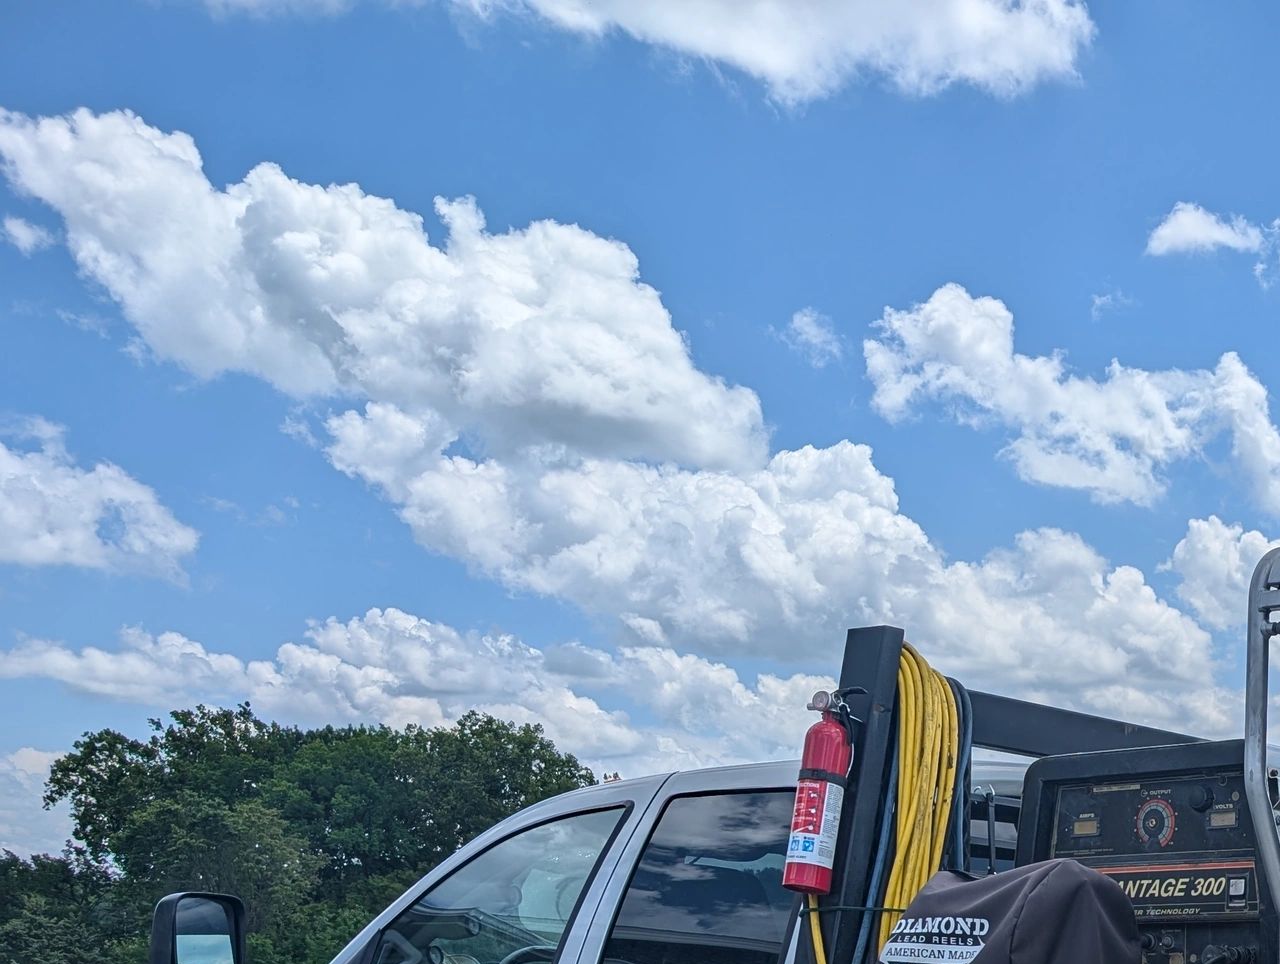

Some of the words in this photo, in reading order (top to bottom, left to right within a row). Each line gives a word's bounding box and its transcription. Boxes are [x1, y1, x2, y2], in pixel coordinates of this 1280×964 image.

[1191, 877, 1226, 896] 300
[1146, 908, 1201, 916] TECHNOLOGY
[892, 917, 989, 936] DIAMOND
[932, 936, 974, 946] REELS
[886, 947, 945, 959] AMERICAN
[948, 951, 978, 960] MADE
